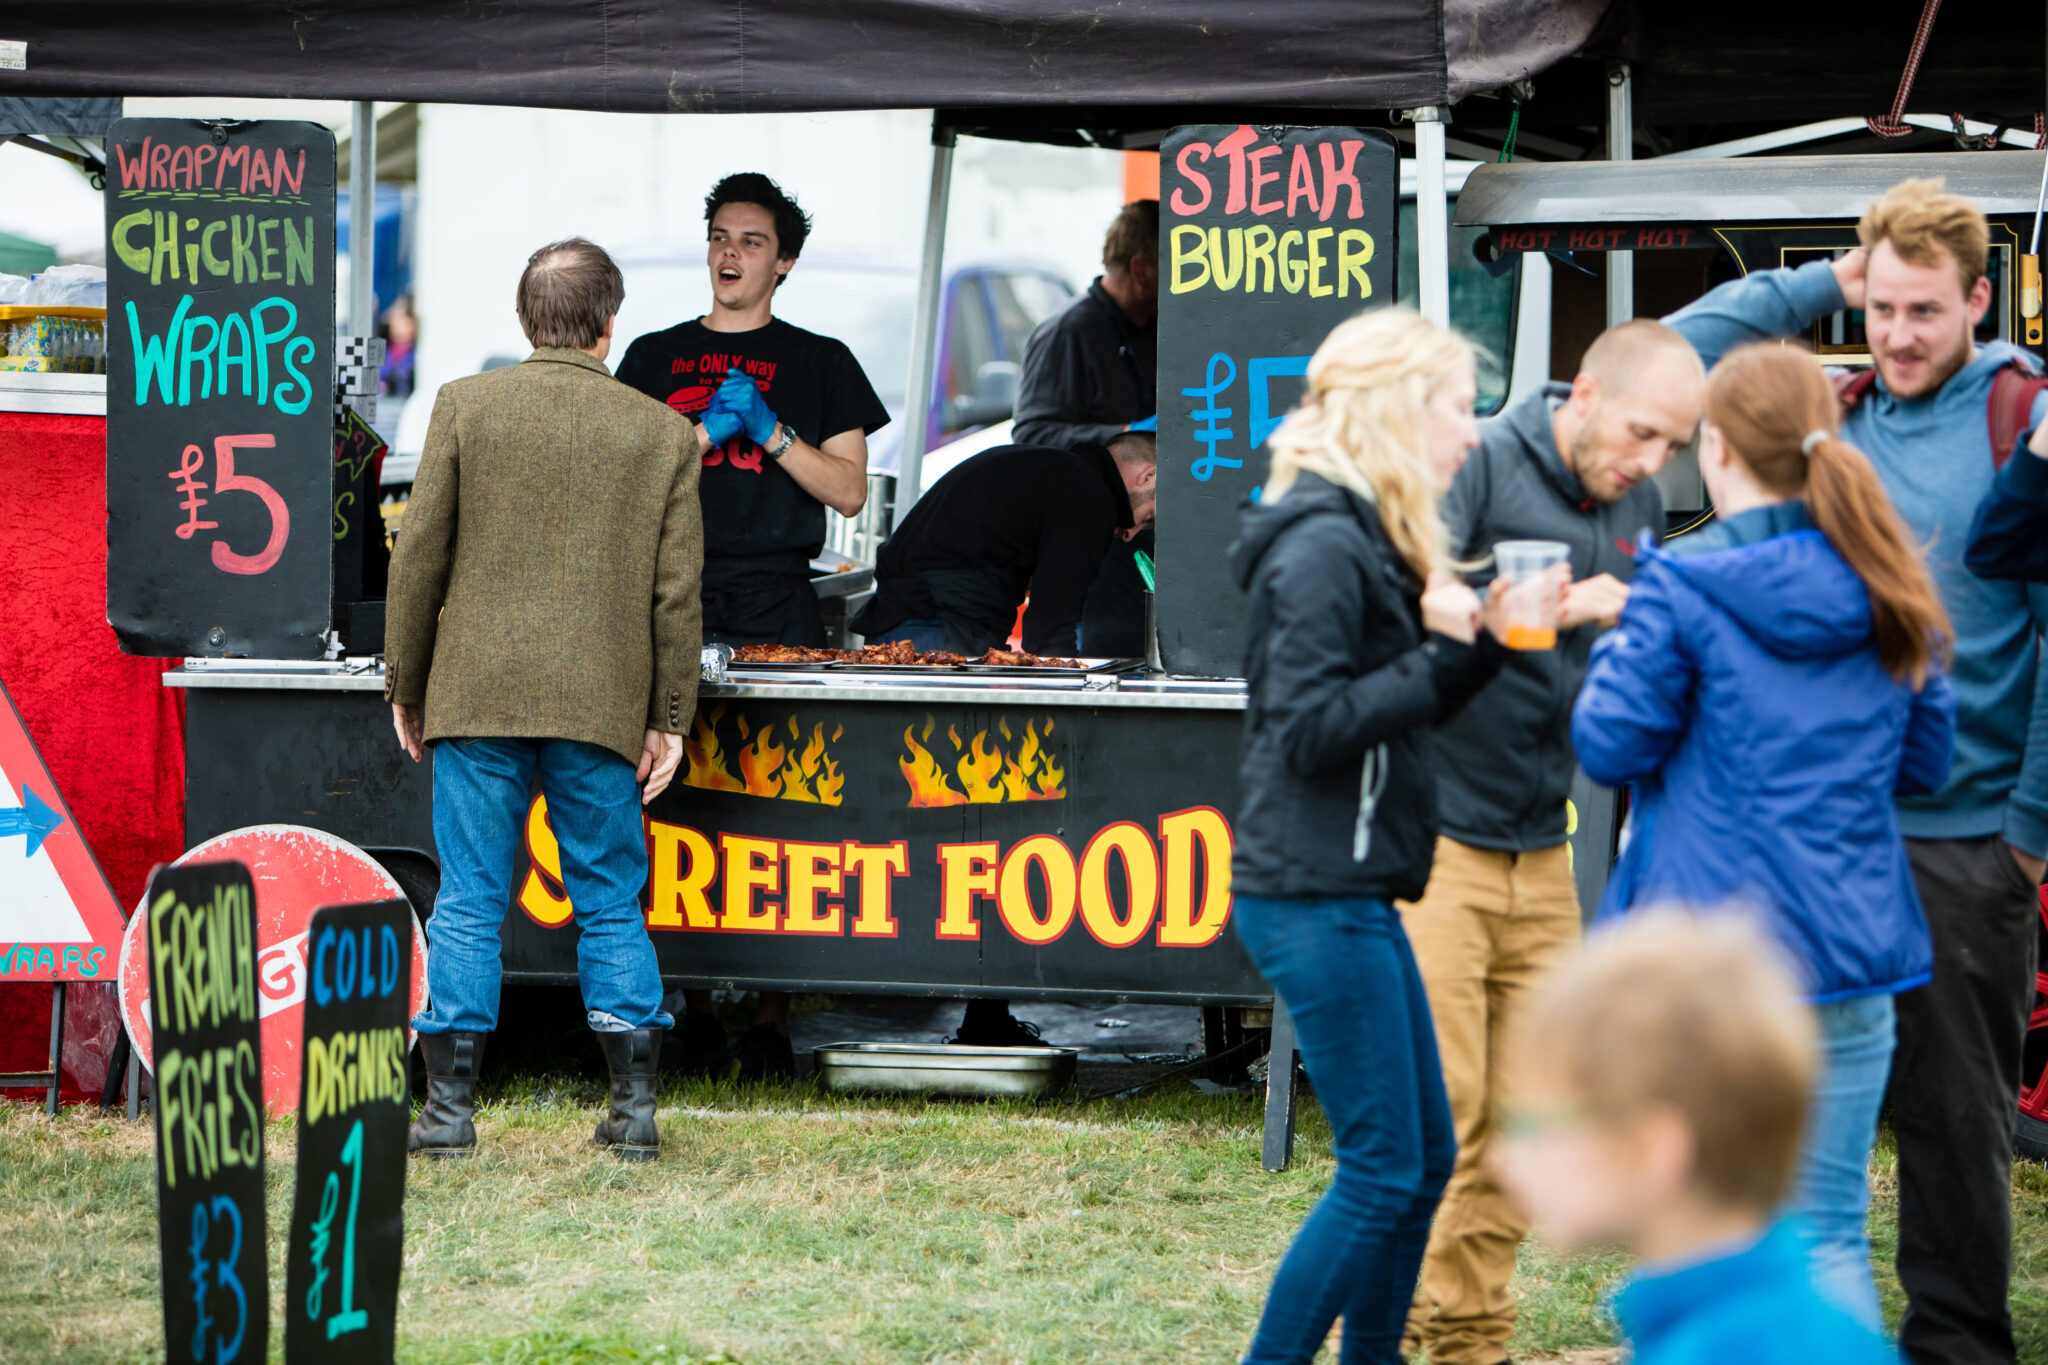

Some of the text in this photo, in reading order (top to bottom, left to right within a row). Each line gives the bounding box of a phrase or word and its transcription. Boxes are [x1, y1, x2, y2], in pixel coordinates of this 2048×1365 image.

[116, 136, 306, 195] WRAPMAN
[1170, 125, 1365, 222] STEAK
[1169, 224, 1375, 299] BURGER
[1501, 227, 1696, 250] HOT HOT HOT
[671, 353, 777, 382] the ONLY way
[169, 433, 291, 576] £5
[517, 791, 1235, 949] SREET FOOD
[150, 883, 255, 1036] FRENCH
[312, 923, 400, 1009] COLD
[305, 1118, 369, 1342] £1
[187, 1193, 249, 1365] £3
